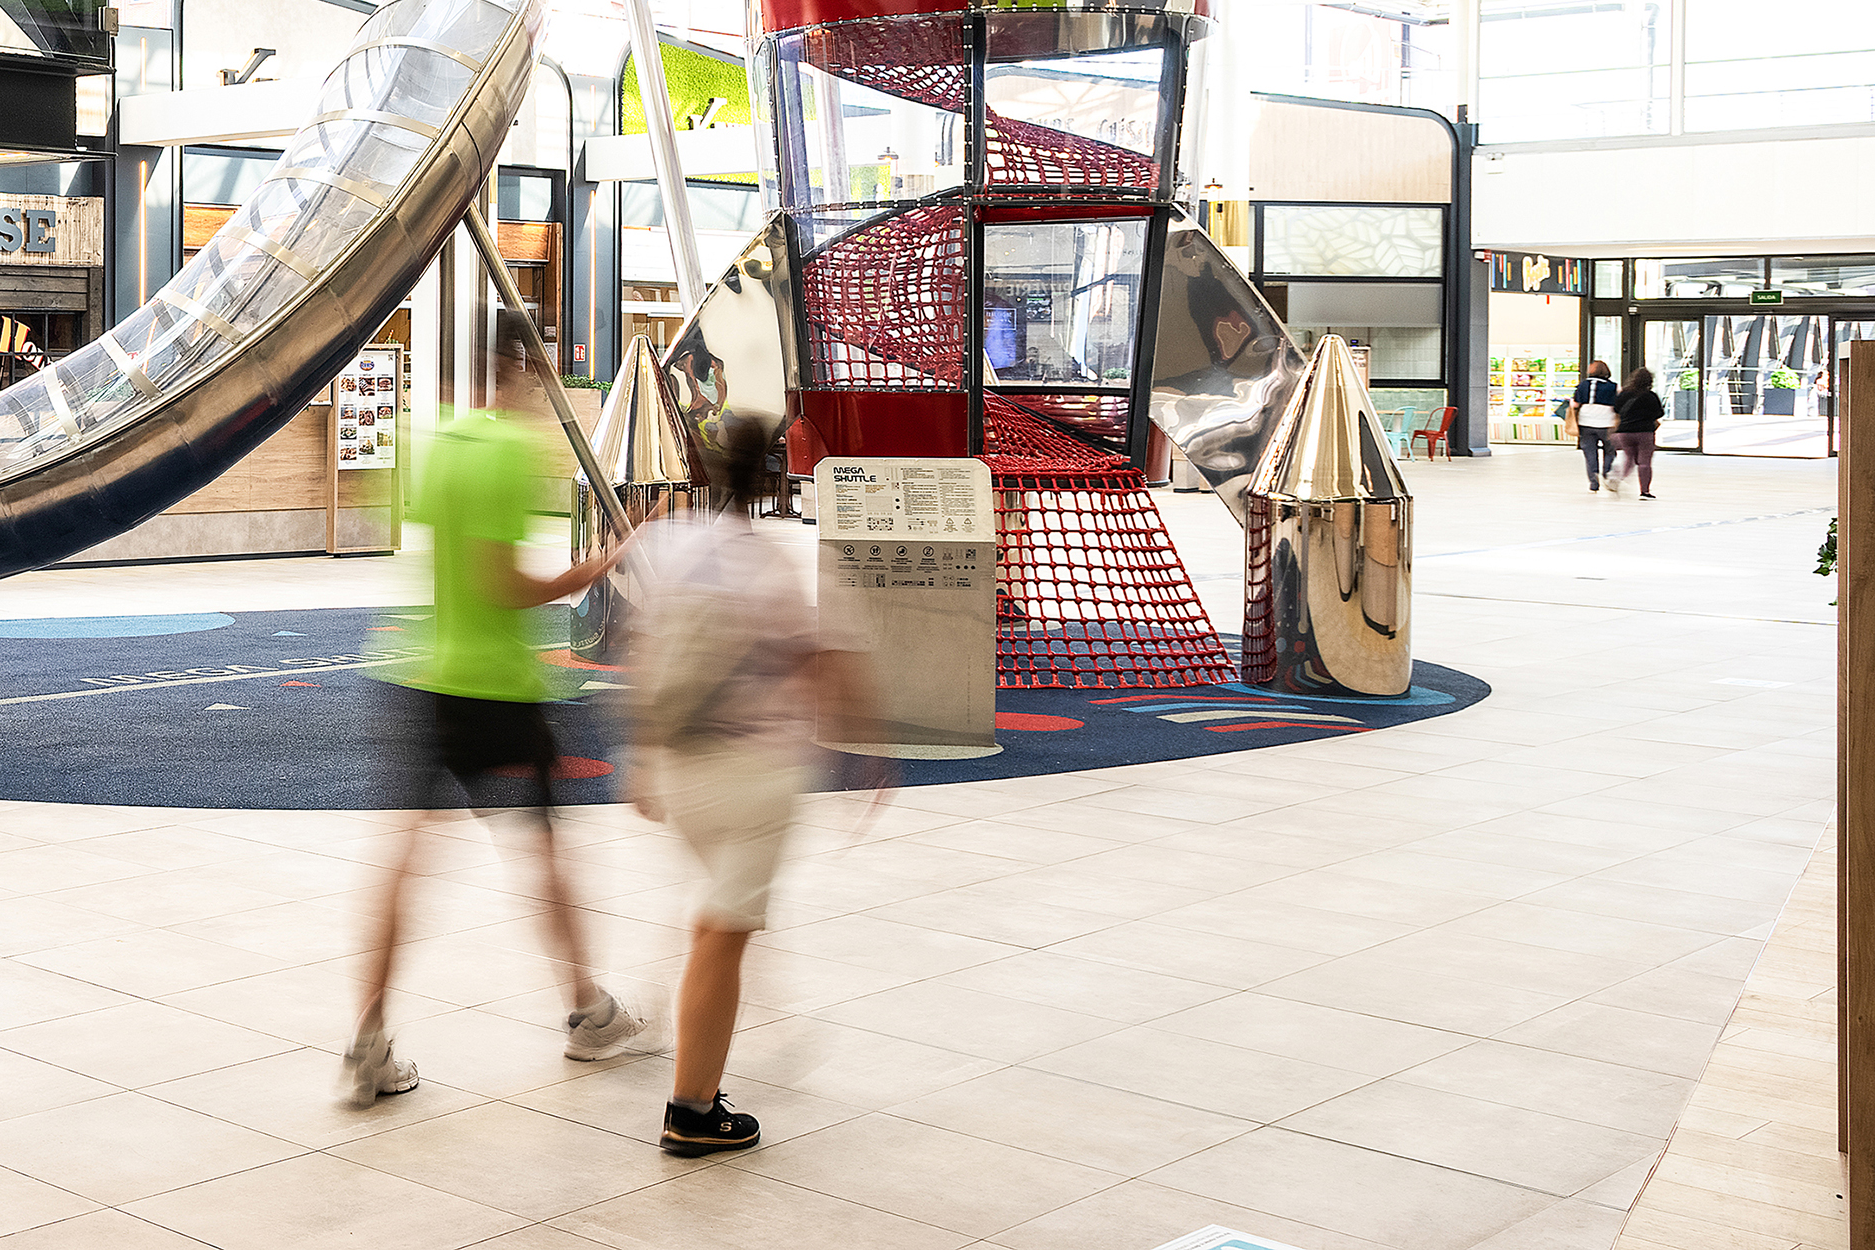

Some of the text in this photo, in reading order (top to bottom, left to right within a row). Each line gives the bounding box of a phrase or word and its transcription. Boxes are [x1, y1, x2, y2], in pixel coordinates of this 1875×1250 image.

[833, 466, 865, 474] MEGA
[833, 475, 877, 483] SHUTTLE
[80, 664, 279, 688] MEGA
